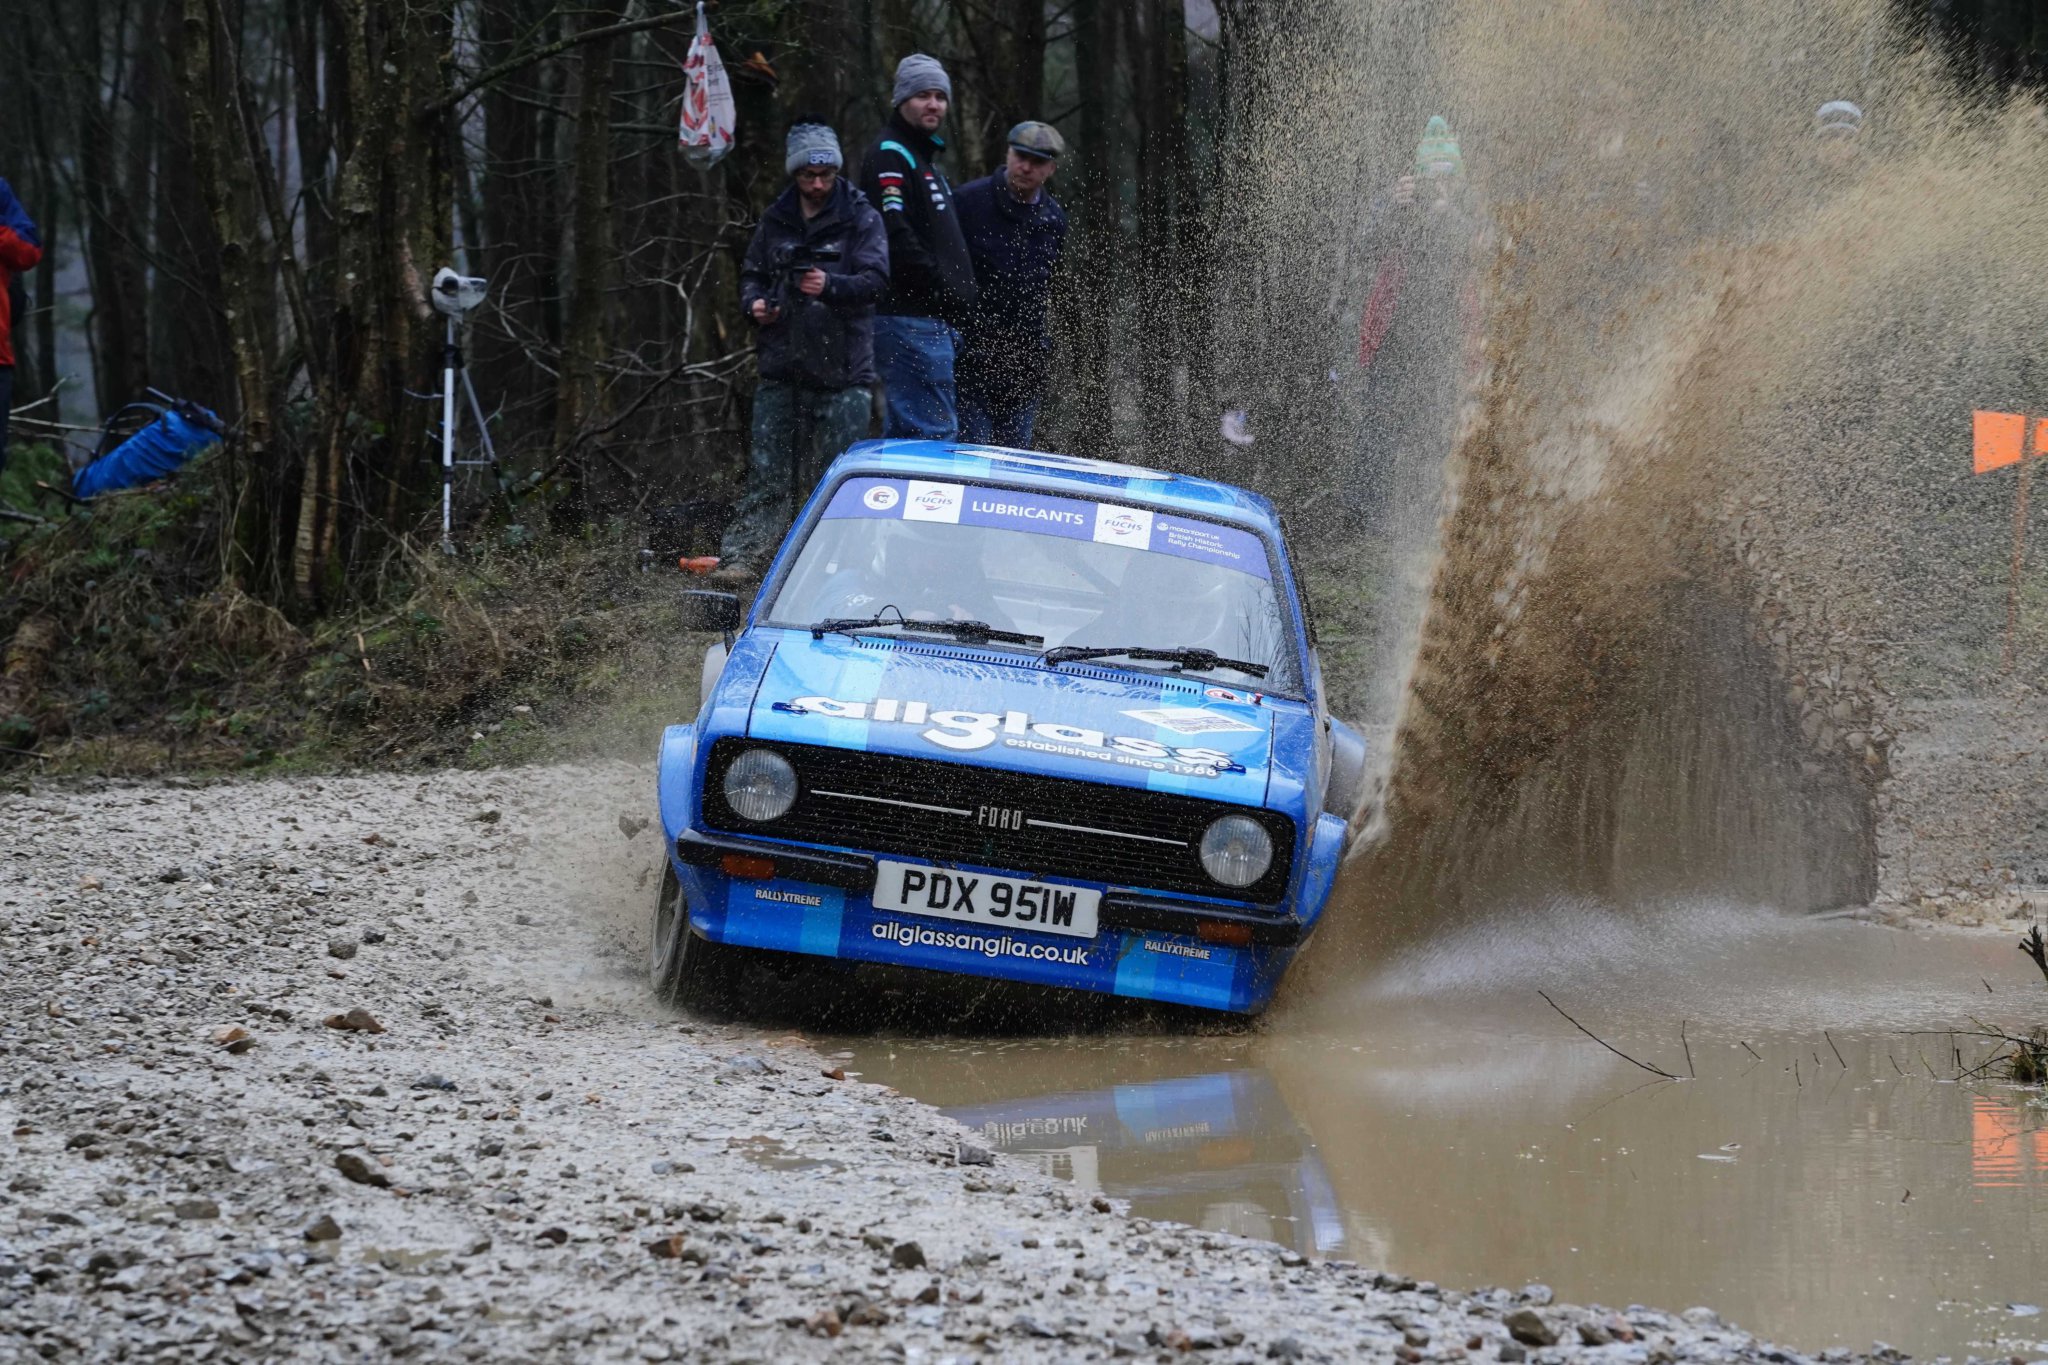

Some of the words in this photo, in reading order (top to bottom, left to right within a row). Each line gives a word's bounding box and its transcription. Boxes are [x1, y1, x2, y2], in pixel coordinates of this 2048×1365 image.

[915, 496, 953, 505] FUCHS
[972, 501, 1084, 525] LUBRICANTS
[1104, 519, 1143, 531] FUCHS
[1168, 532, 1193, 542] British
[1194, 536, 1223, 549] Historic
[1168, 538, 1187, 548] Rally
[1187, 542, 1241, 560] Championship
[793, 696, 1233, 768] allglass
[1005, 737, 1111, 761] established
[1116, 755, 1165, 770] since
[978, 805, 1022, 830] FORD
[900, 869, 979, 914] PDX
[989, 882, 1077, 927] 951W
[872, 922, 1089, 966] allglassanglia.co.uk
